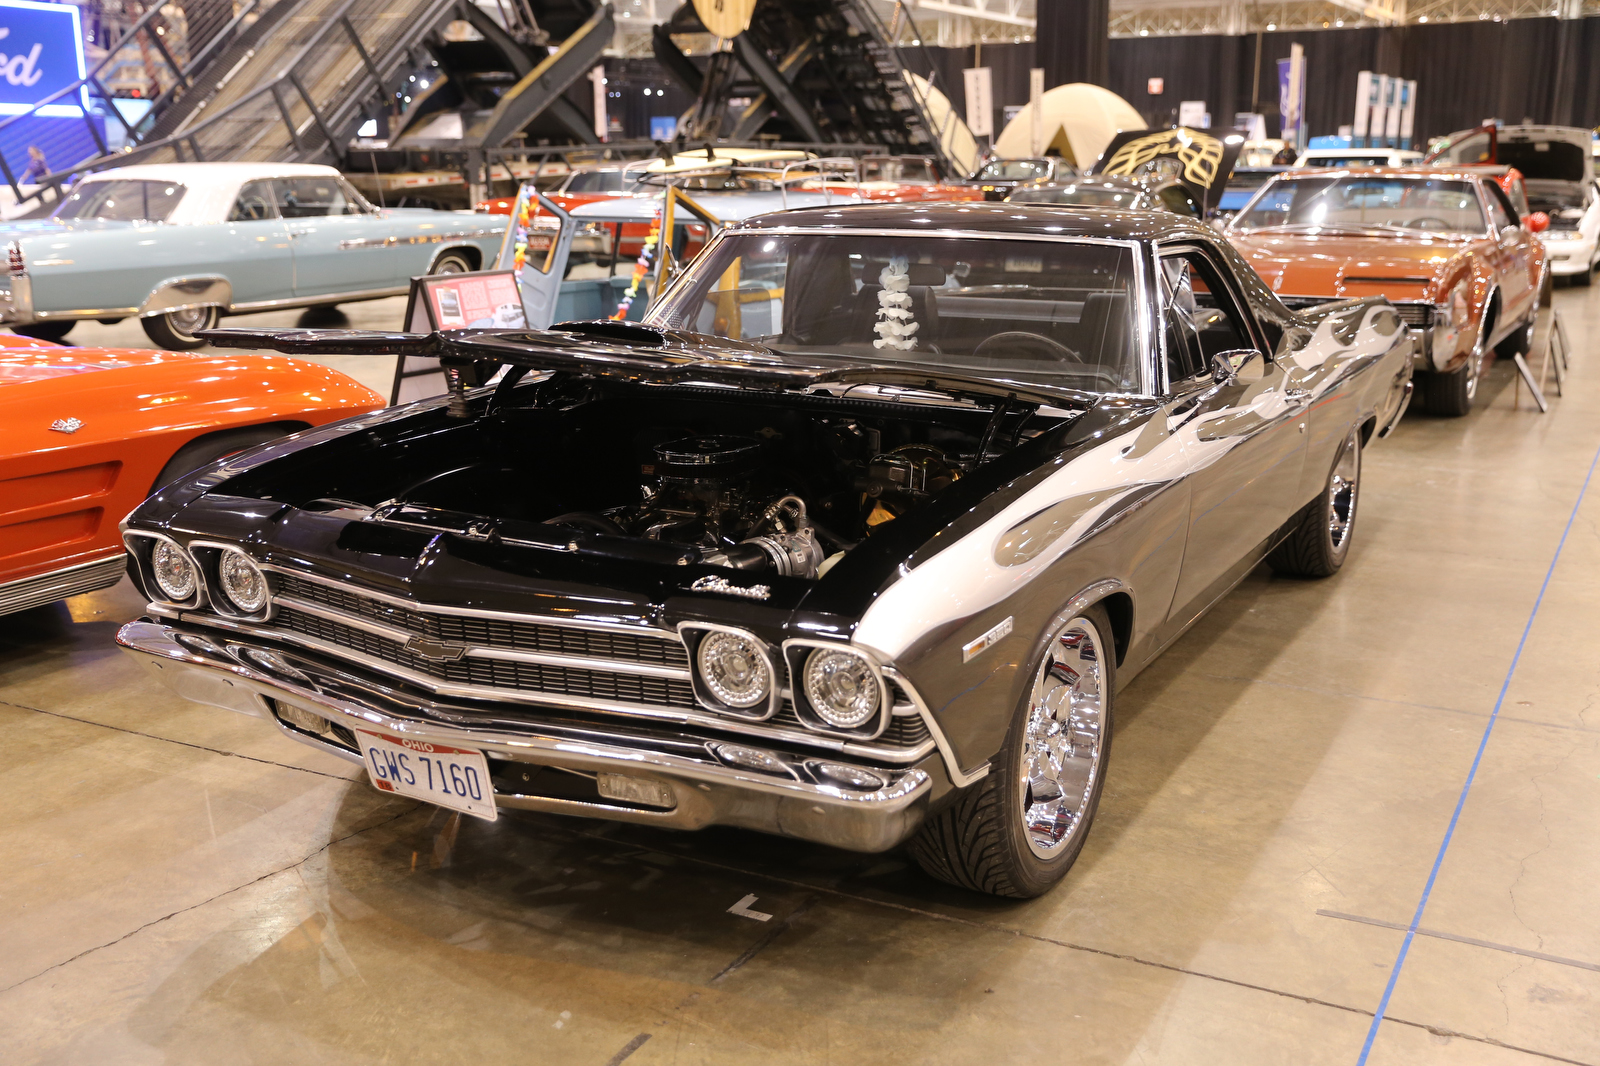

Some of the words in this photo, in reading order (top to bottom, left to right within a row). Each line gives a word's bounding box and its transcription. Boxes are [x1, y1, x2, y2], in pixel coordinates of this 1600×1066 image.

[401, 738, 434, 753] OHIO
[369, 747, 416, 785] GWS
[419, 756, 482, 801] 7160
